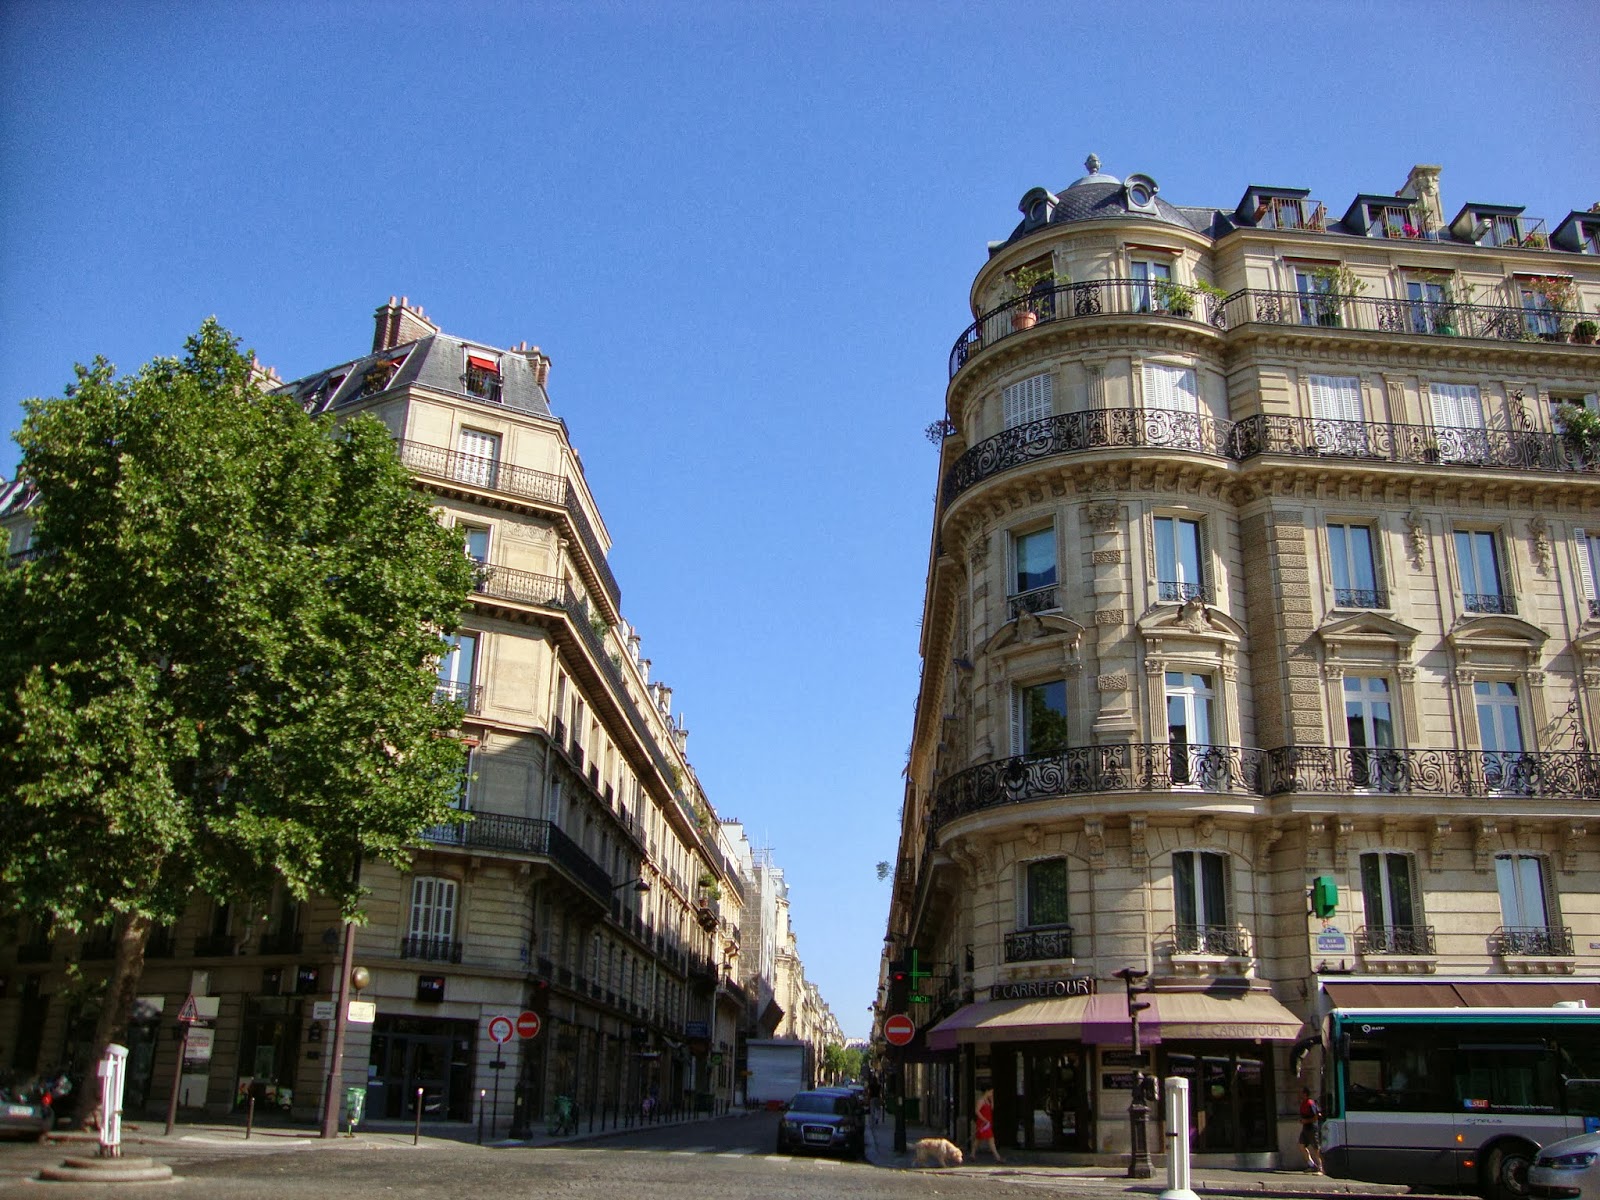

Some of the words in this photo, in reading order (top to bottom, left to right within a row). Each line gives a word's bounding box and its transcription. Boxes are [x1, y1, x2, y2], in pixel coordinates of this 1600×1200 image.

[1003, 980, 1088, 998] CARREFOUR
[1188, 1026, 1203, 1036] LE
[1212, 1025, 1281, 1037] CARREFOUR
